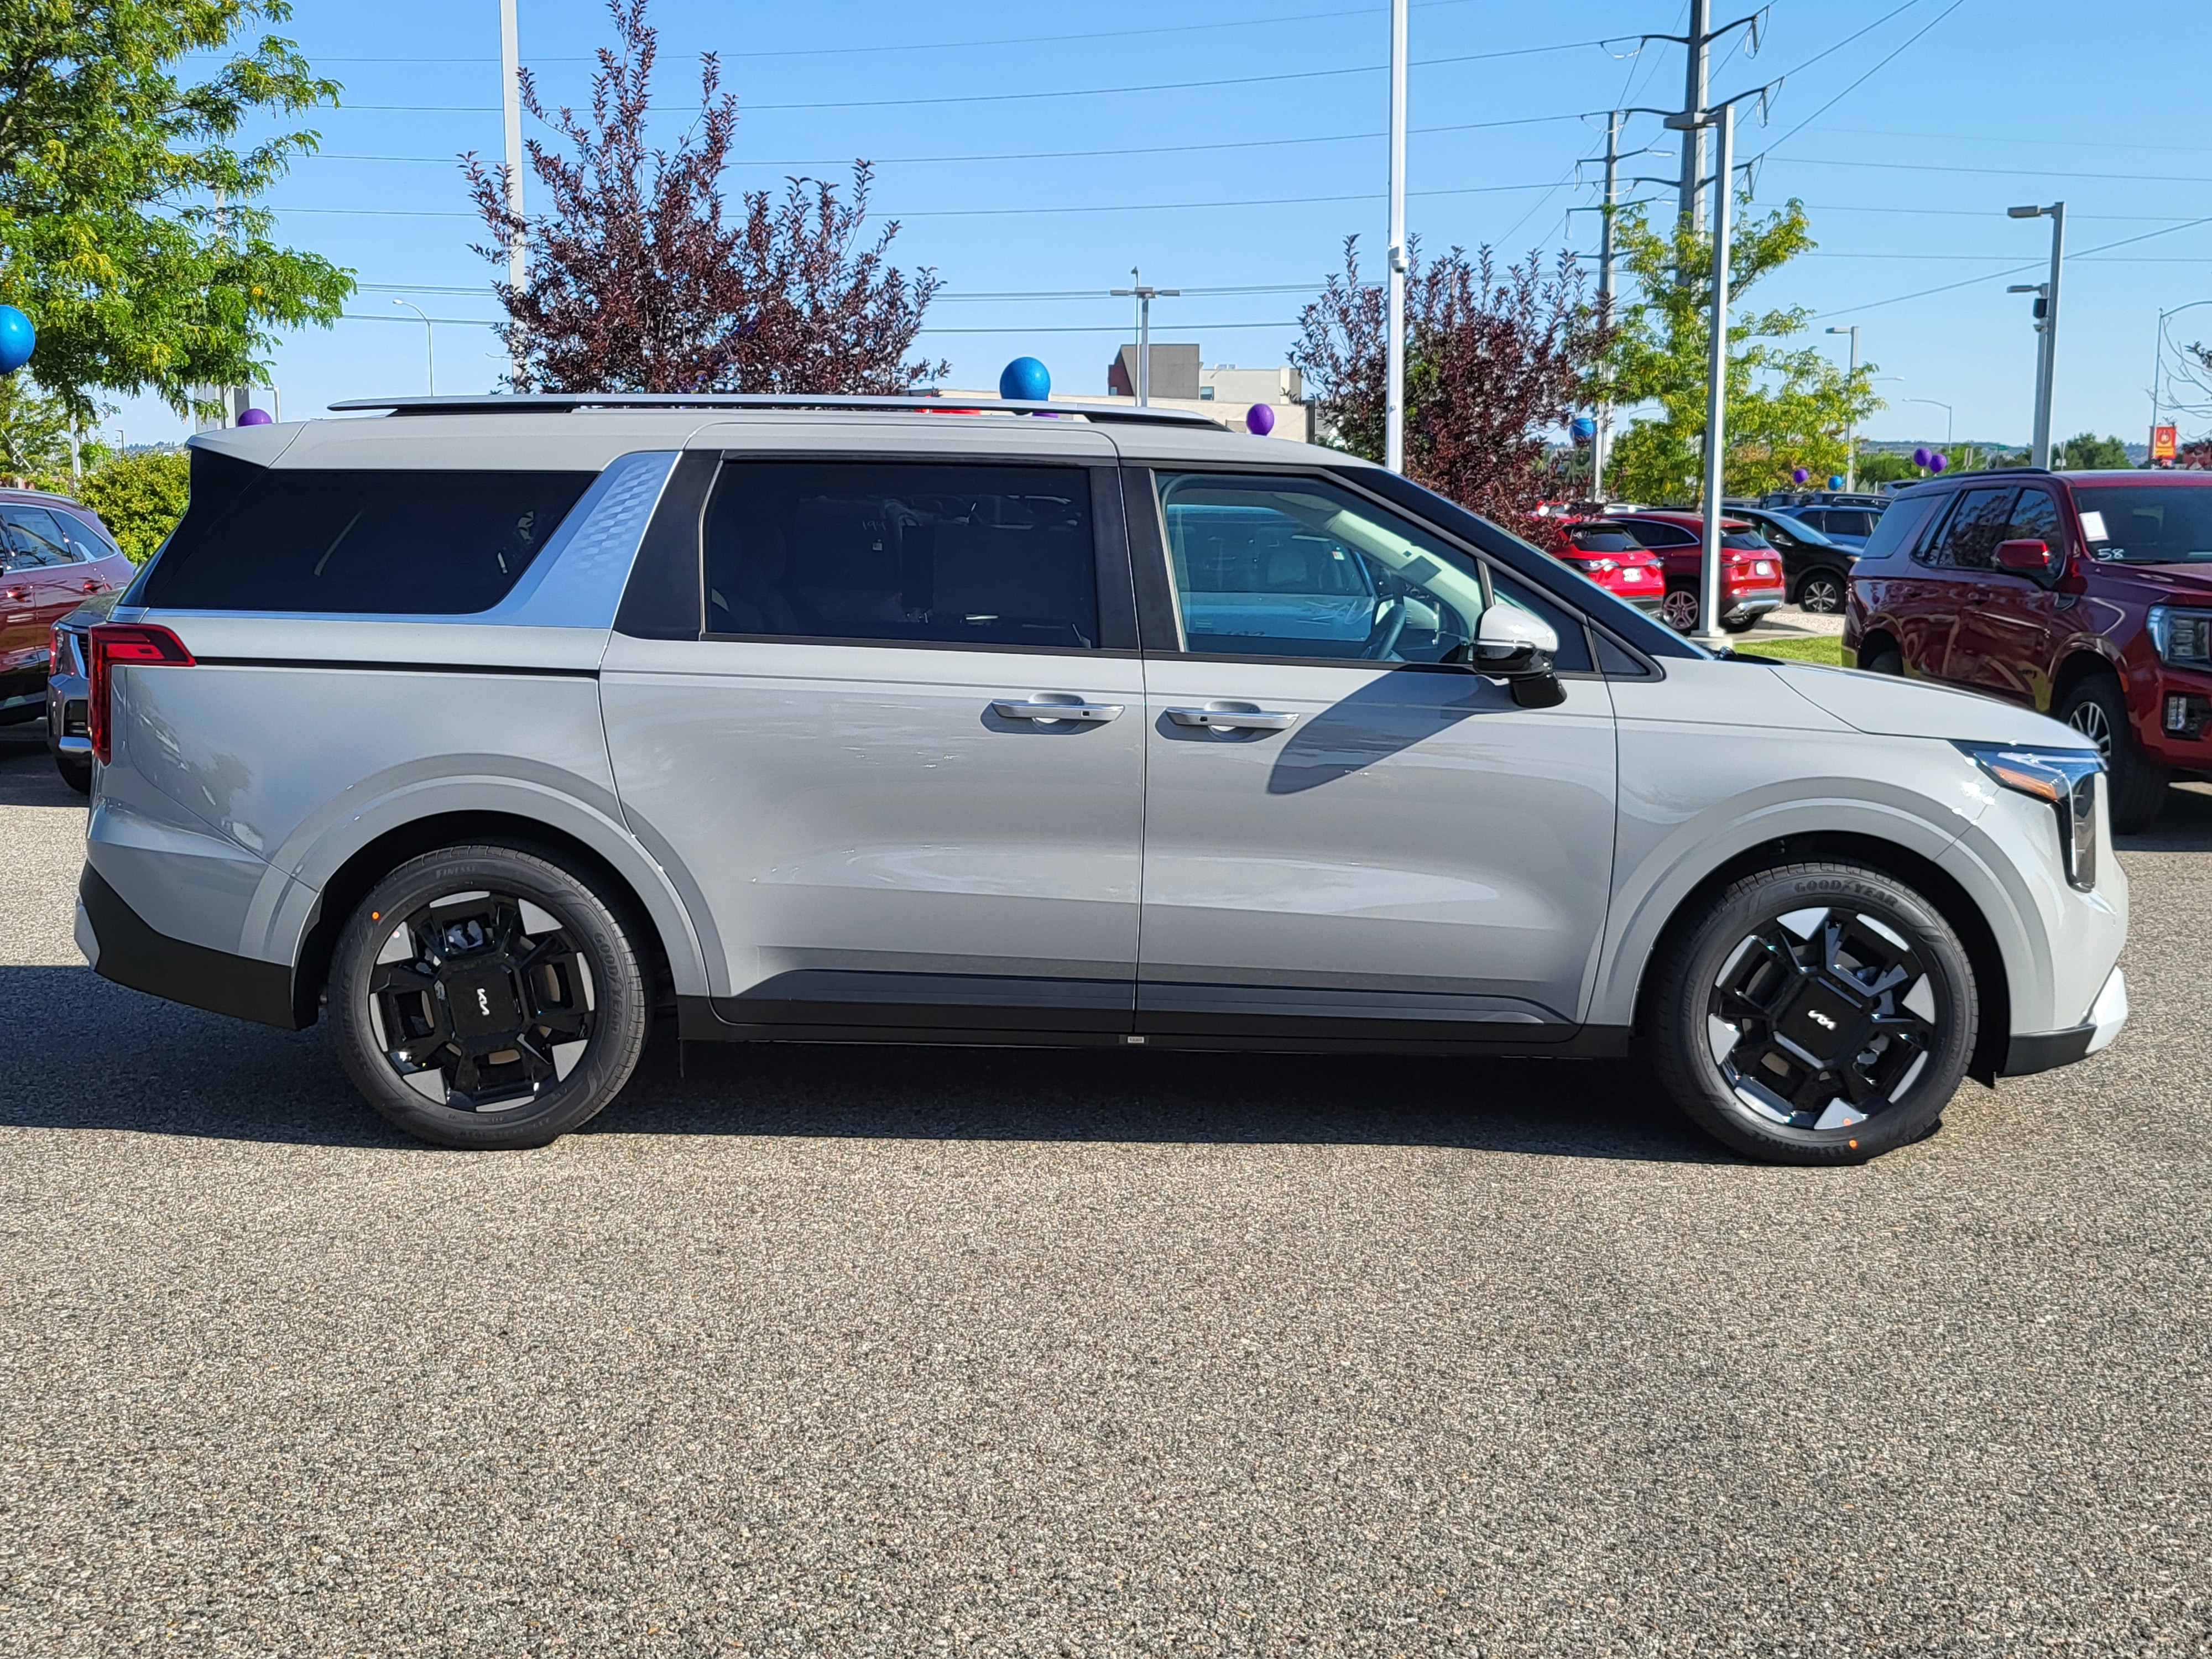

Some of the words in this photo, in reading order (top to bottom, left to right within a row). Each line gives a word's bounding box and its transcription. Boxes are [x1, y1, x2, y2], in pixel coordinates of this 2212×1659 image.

[2096, 548, 2124, 561] 58
[477, 988, 489, 1016] KIA
[1808, 1010, 1837, 1030] KIA
